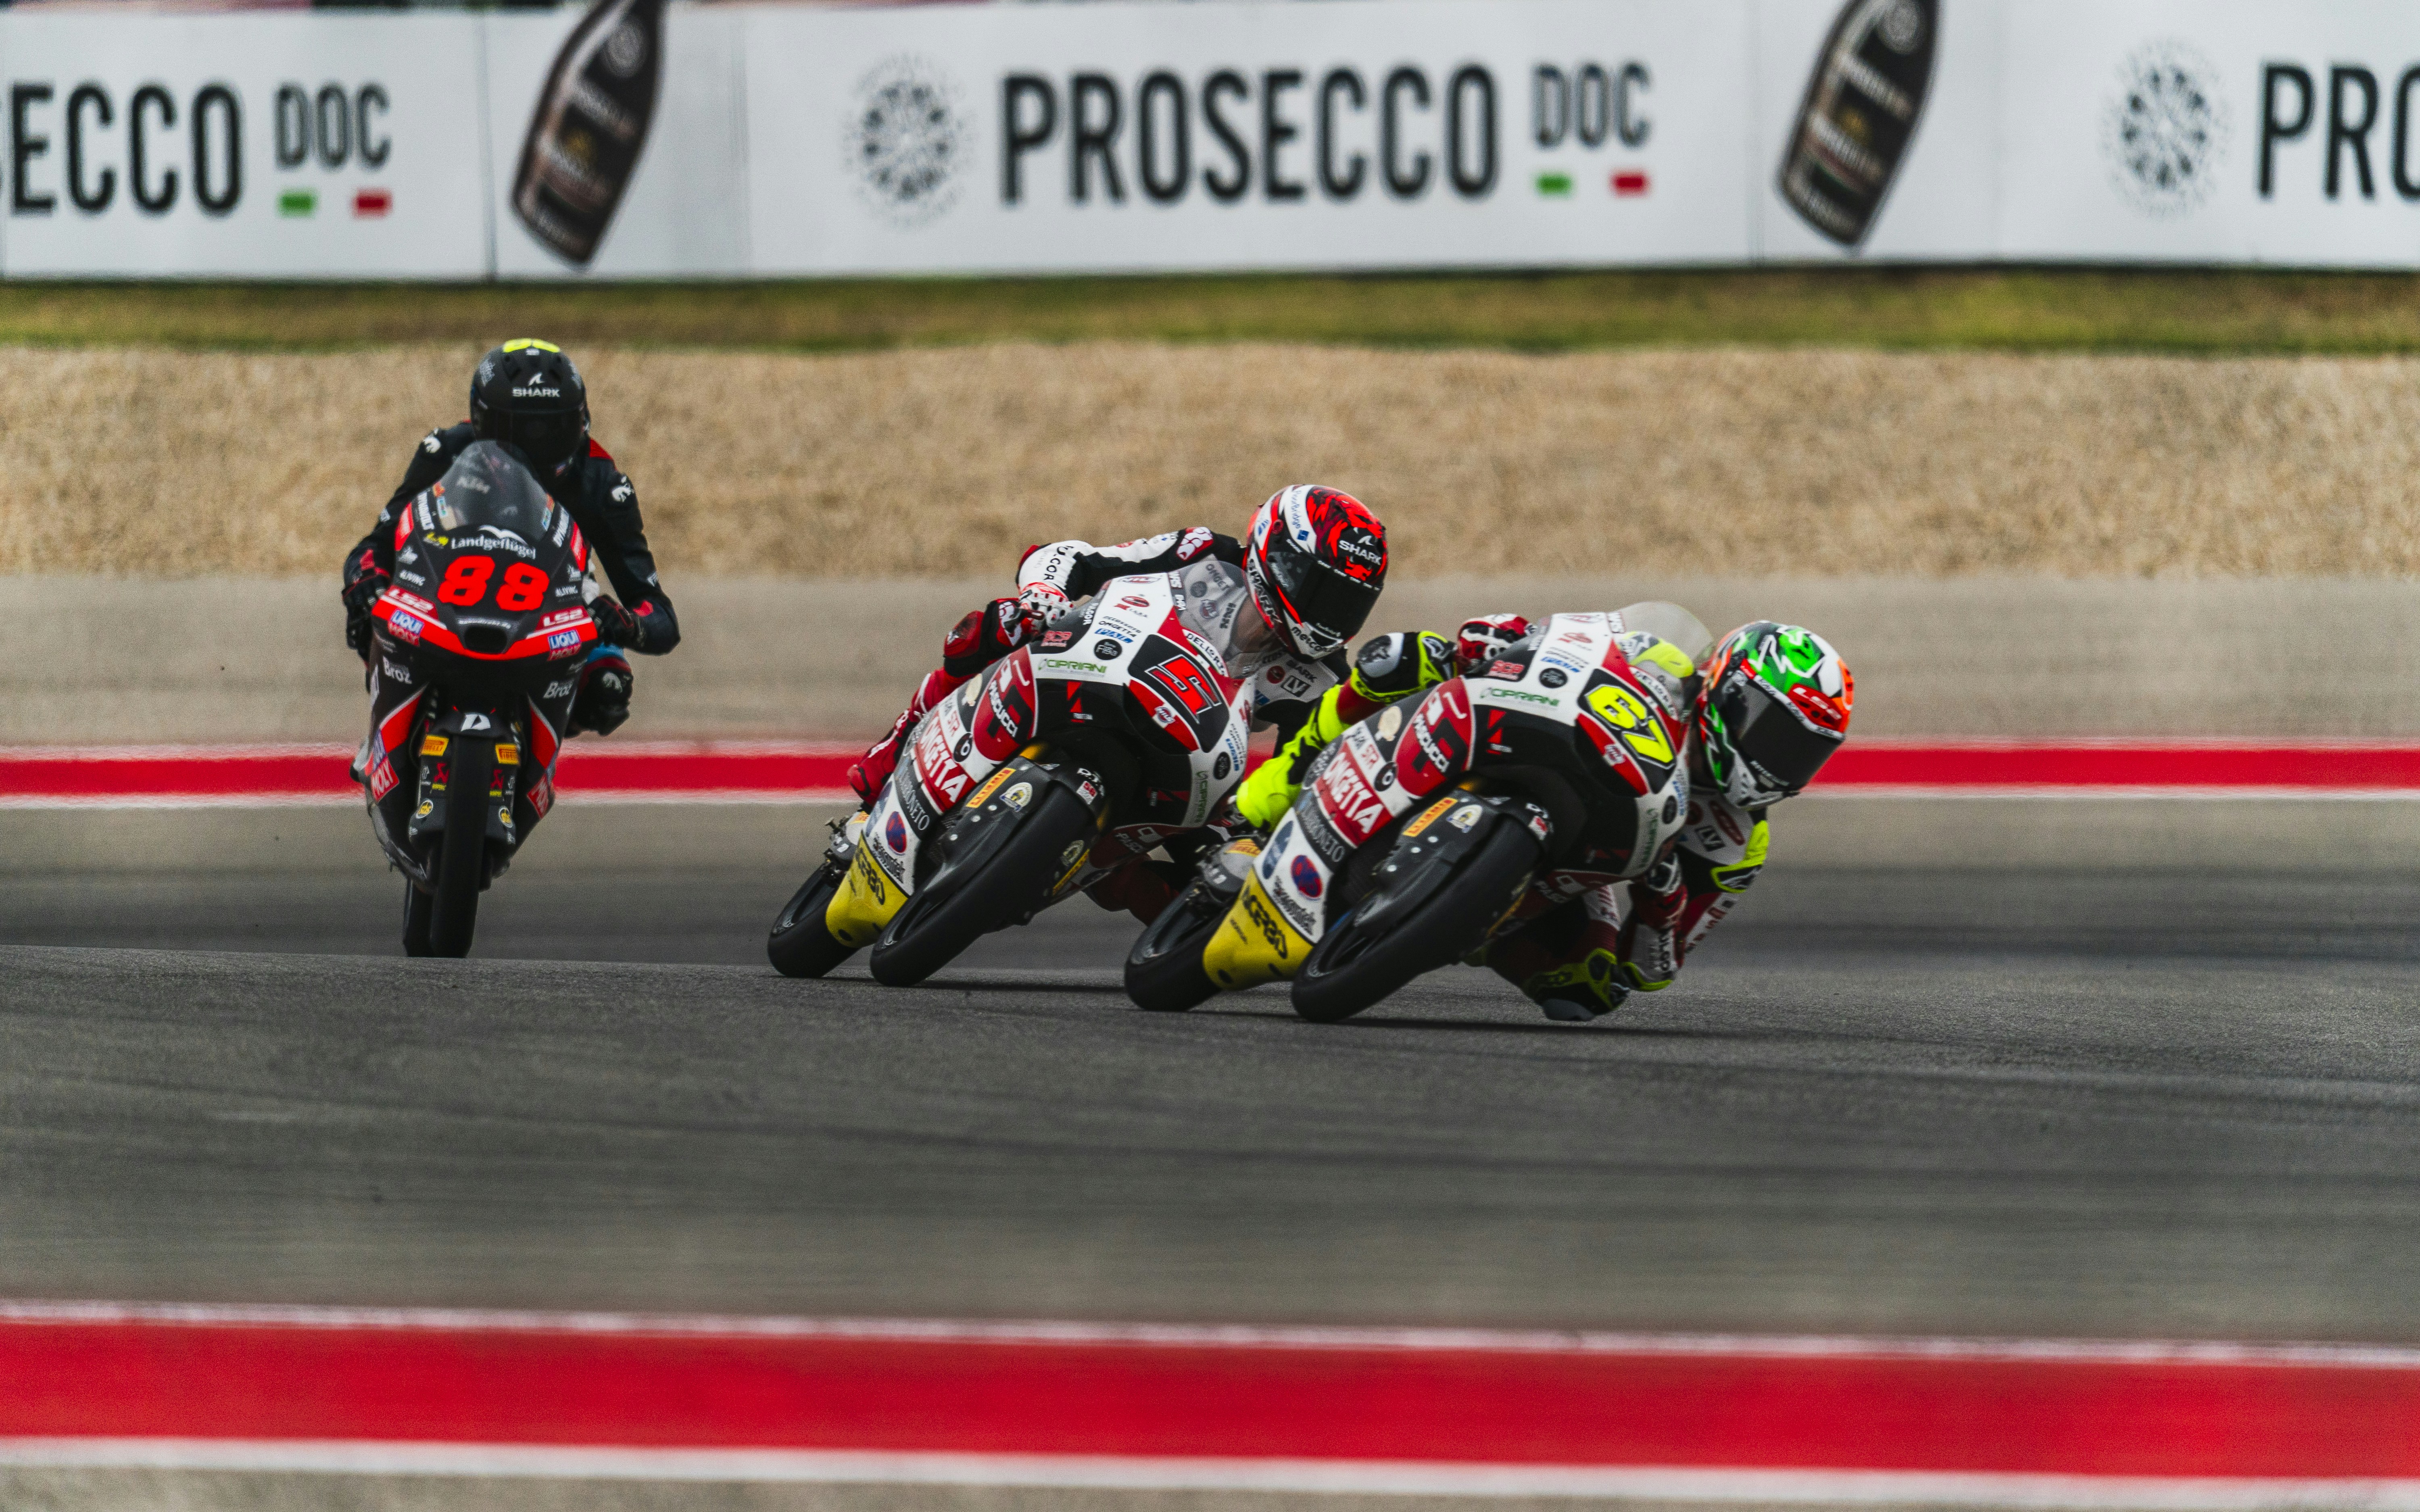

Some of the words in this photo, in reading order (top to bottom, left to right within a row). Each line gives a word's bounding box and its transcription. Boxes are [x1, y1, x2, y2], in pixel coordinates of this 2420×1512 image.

[1, 82, 244, 217] ECCO
[275, 82, 392, 170] DOC
[999, 62, 1501, 206] PROSECCO
[1530, 60, 1653, 149] DOC
[512, 387, 560, 398] SHARK
[451, 534, 536, 560] Landgeflügel
[1338, 539, 1382, 565] SHARK
[437, 555, 549, 611] 88
[543, 607, 583, 627] LS2
[1144, 654, 1222, 724] 5
[1585, 684, 1675, 768] 67
